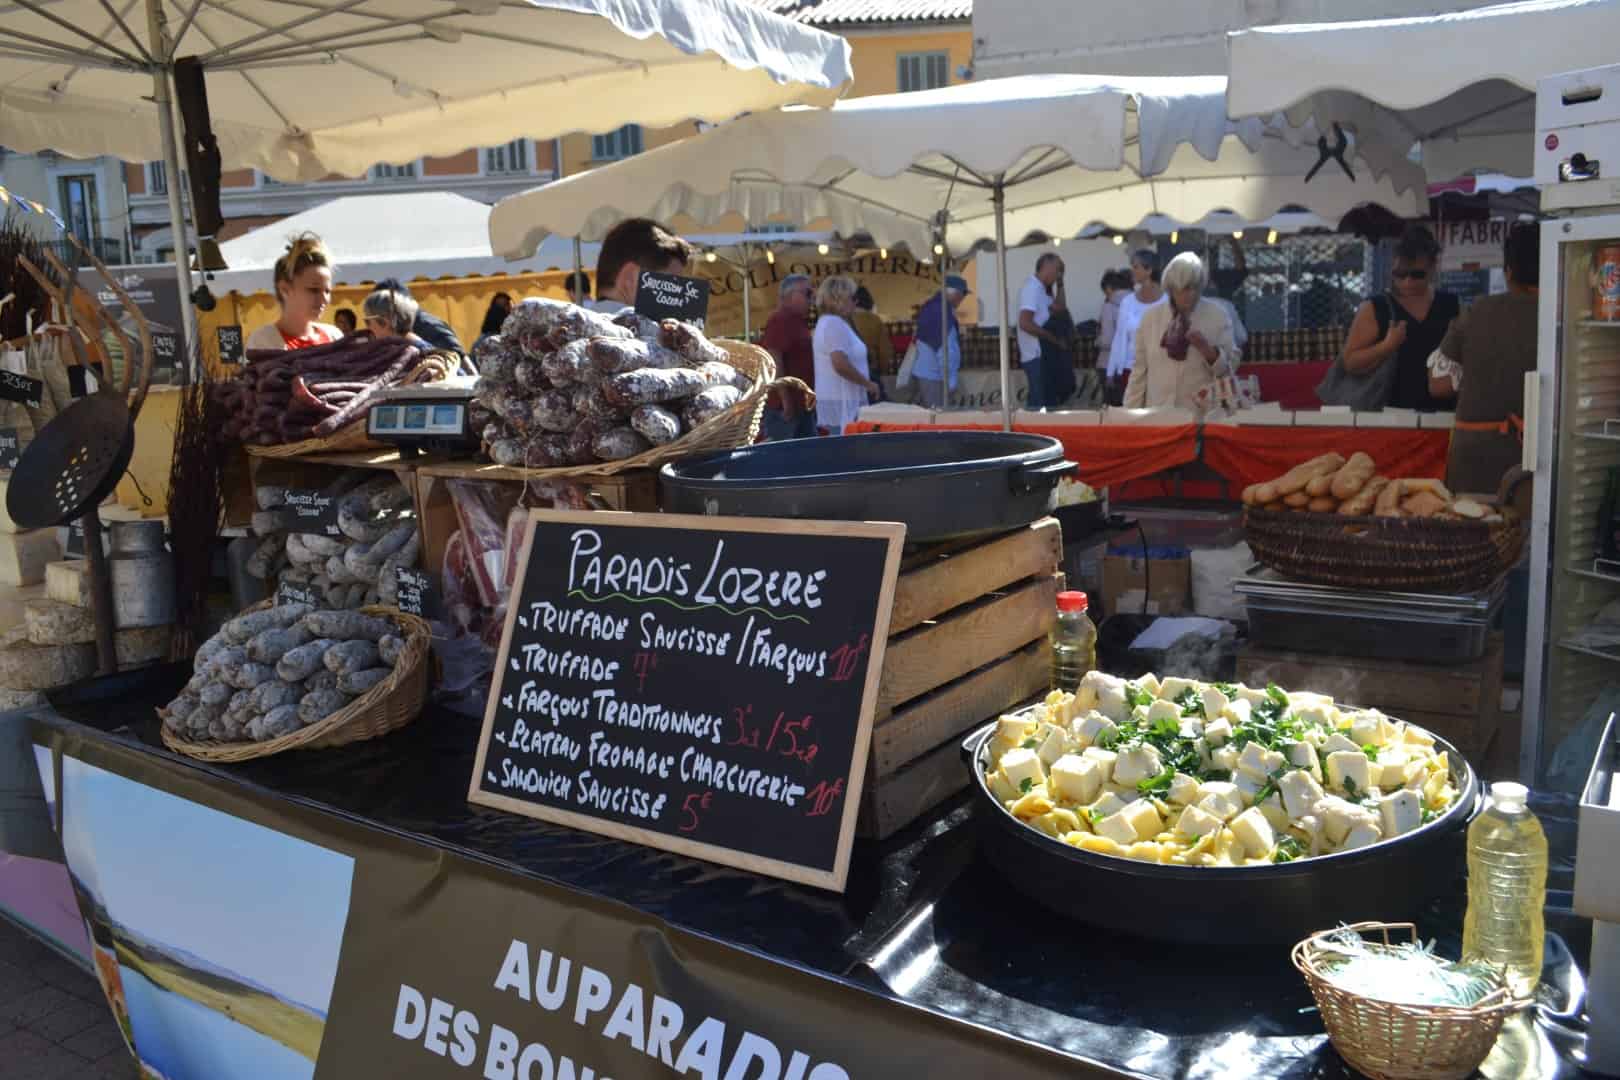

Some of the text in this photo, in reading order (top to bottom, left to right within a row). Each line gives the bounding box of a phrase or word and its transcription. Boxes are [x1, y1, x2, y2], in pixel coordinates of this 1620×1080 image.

[530, 601, 630, 641] TRUFFADE
[521, 643, 620, 682] TRUFFADE
[508, 718, 581, 761] PLATEAU
[588, 731, 675, 778] FROMAGE
[576, 770, 668, 820] SAUCISSE
[494, 938, 571, 1011] AU
[393, 984, 616, 1080] DES BO
